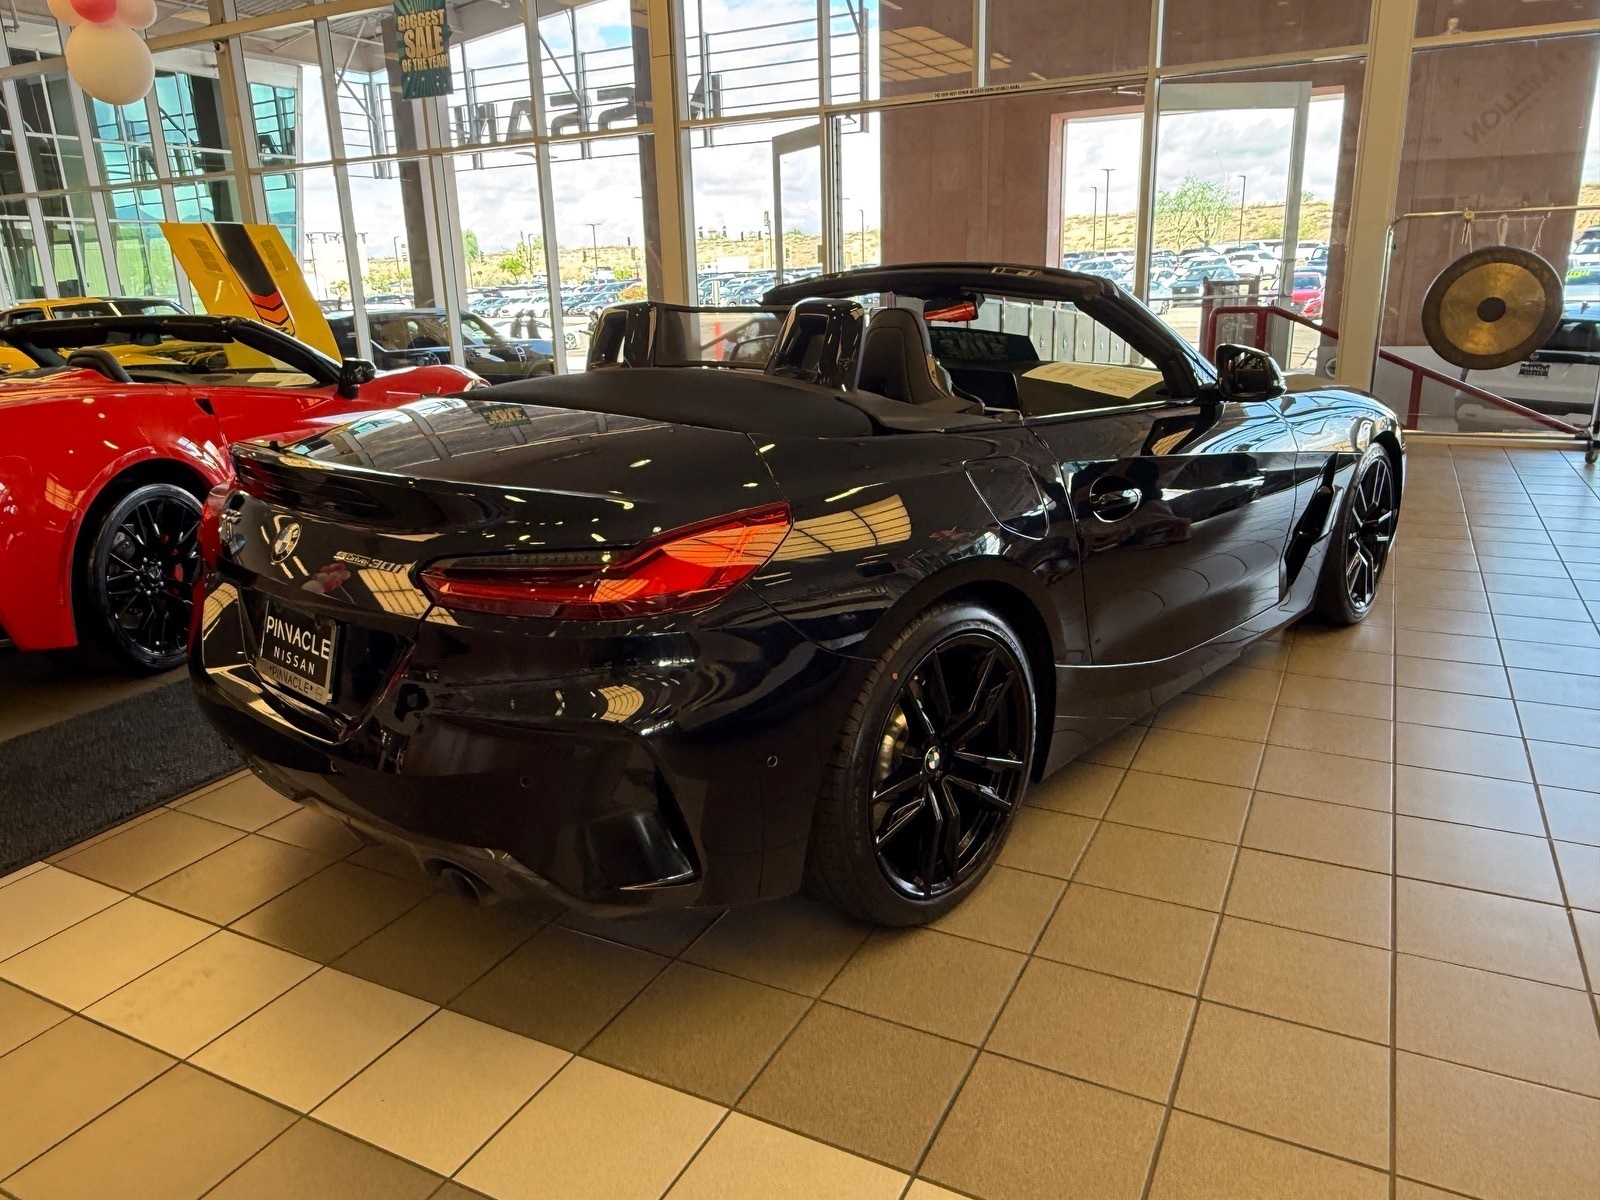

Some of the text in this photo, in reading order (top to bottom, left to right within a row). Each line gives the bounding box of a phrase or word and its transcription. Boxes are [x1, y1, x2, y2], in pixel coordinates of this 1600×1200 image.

[397, 9, 445, 31] BIGGEST
[403, 26, 444, 58] SALE
[401, 58, 412, 73] OF
[412, 57, 428, 71] THE
[266, 615, 331, 660] PINNACLE
[273, 646, 315, 675] NISSAN
